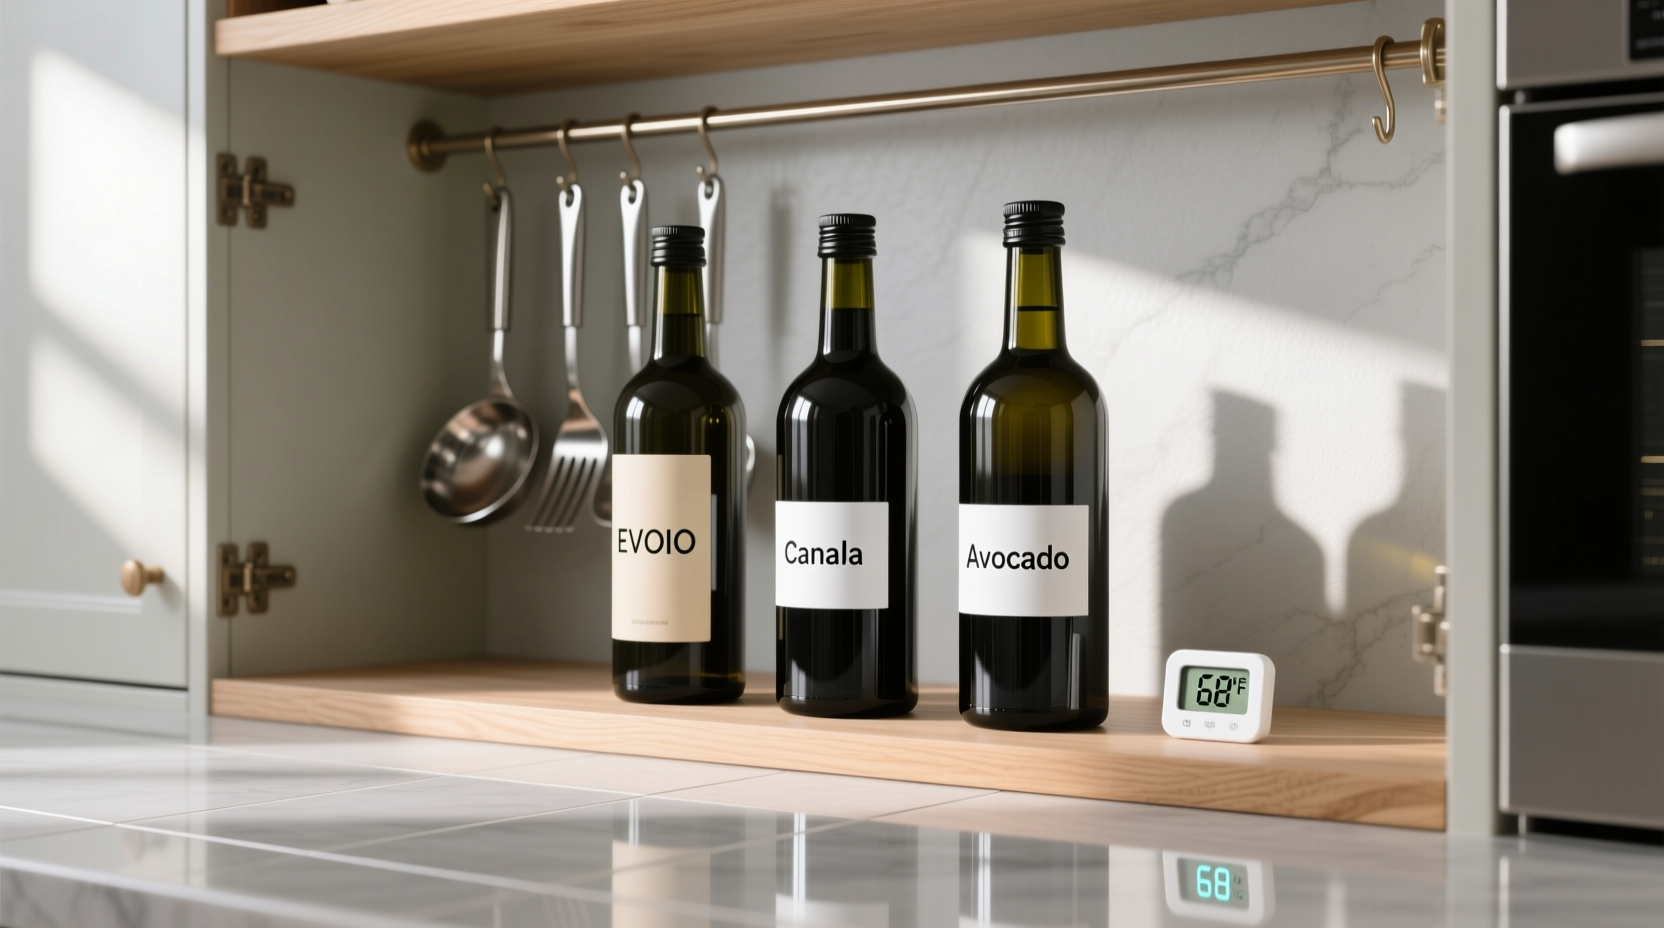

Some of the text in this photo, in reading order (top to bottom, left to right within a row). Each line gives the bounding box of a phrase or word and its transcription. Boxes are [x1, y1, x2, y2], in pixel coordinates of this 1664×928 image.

[618, 528, 696, 555] EVOIO
[784, 540, 863, 566] Canala
[966, 543, 1070, 570] Avocado
